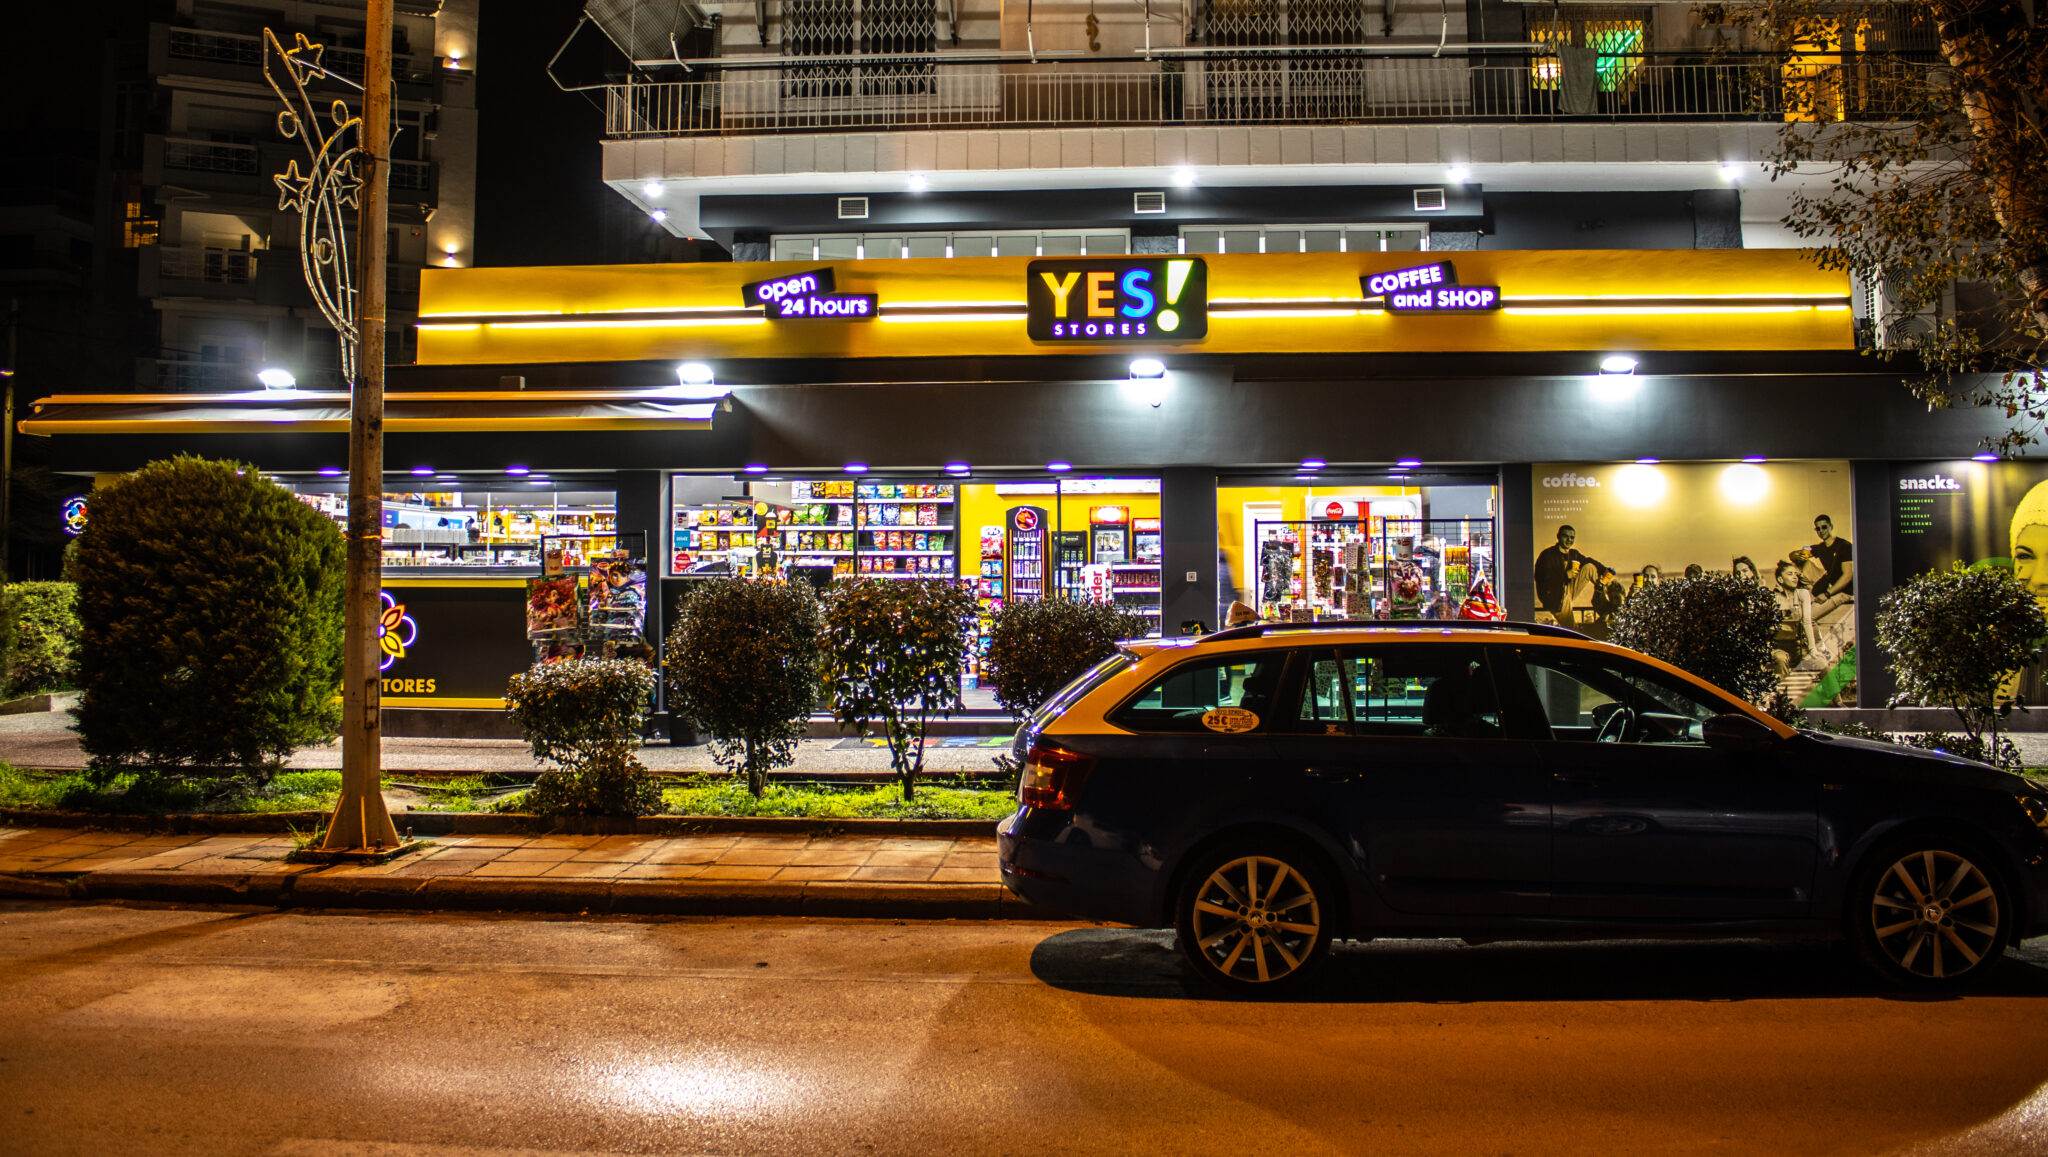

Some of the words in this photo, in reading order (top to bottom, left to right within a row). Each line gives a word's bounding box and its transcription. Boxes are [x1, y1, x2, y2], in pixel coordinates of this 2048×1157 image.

[758, 275, 817, 302] open
[1370, 266, 1442, 294] COFFEE
[1040, 259, 1194, 332] YES!
[1393, 290, 1432, 307] and
[1437, 290, 1494, 307] SHOP
[781, 299, 805, 315] 24
[810, 297, 868, 315] hours
[1054, 323, 1147, 336] STORES
[1542, 472, 1601, 488] coffee.
[1899, 474, 1961, 490] snacks.
[380, 678, 437, 693] TORES
